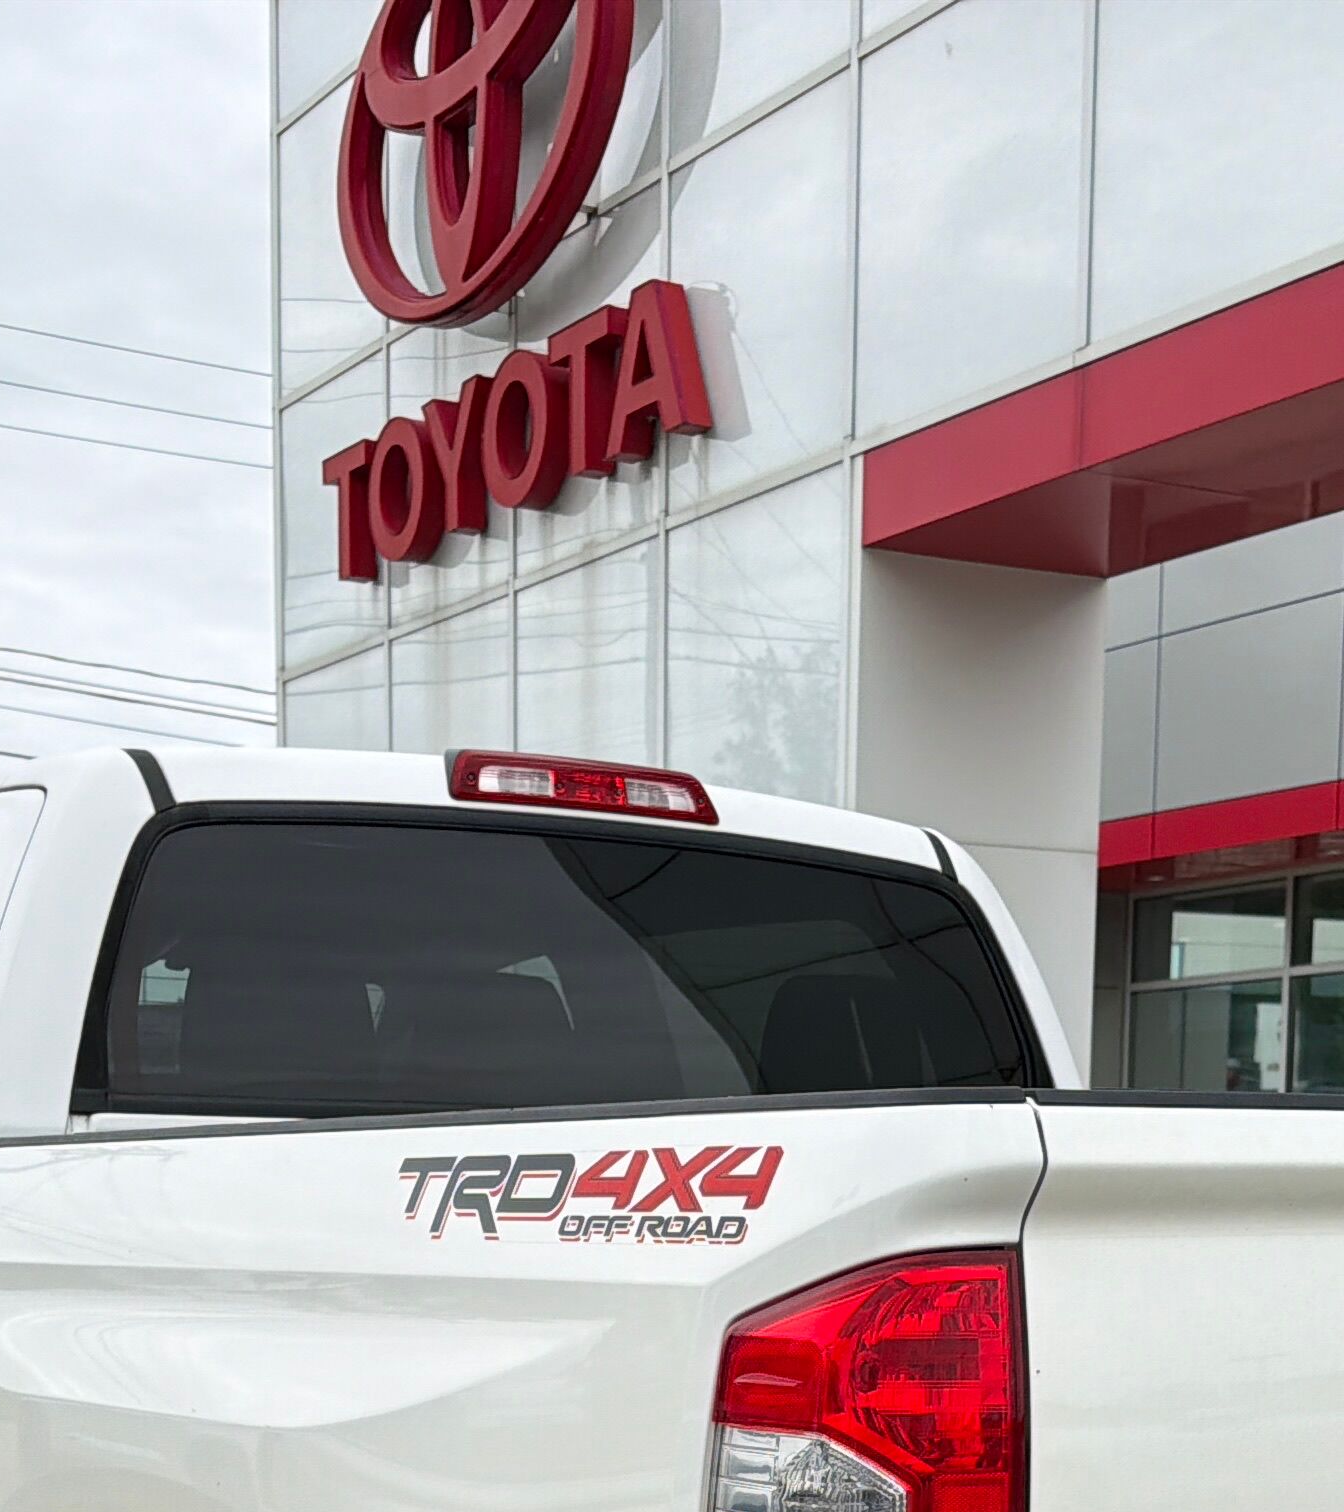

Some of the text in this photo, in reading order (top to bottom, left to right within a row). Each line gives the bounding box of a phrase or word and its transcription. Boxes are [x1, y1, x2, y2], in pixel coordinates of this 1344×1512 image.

[322, 279, 712, 582] TOYOTA
[399, 1146, 784, 1240] TRD 4X4
[558, 1215, 748, 1244] OFF ROAD
